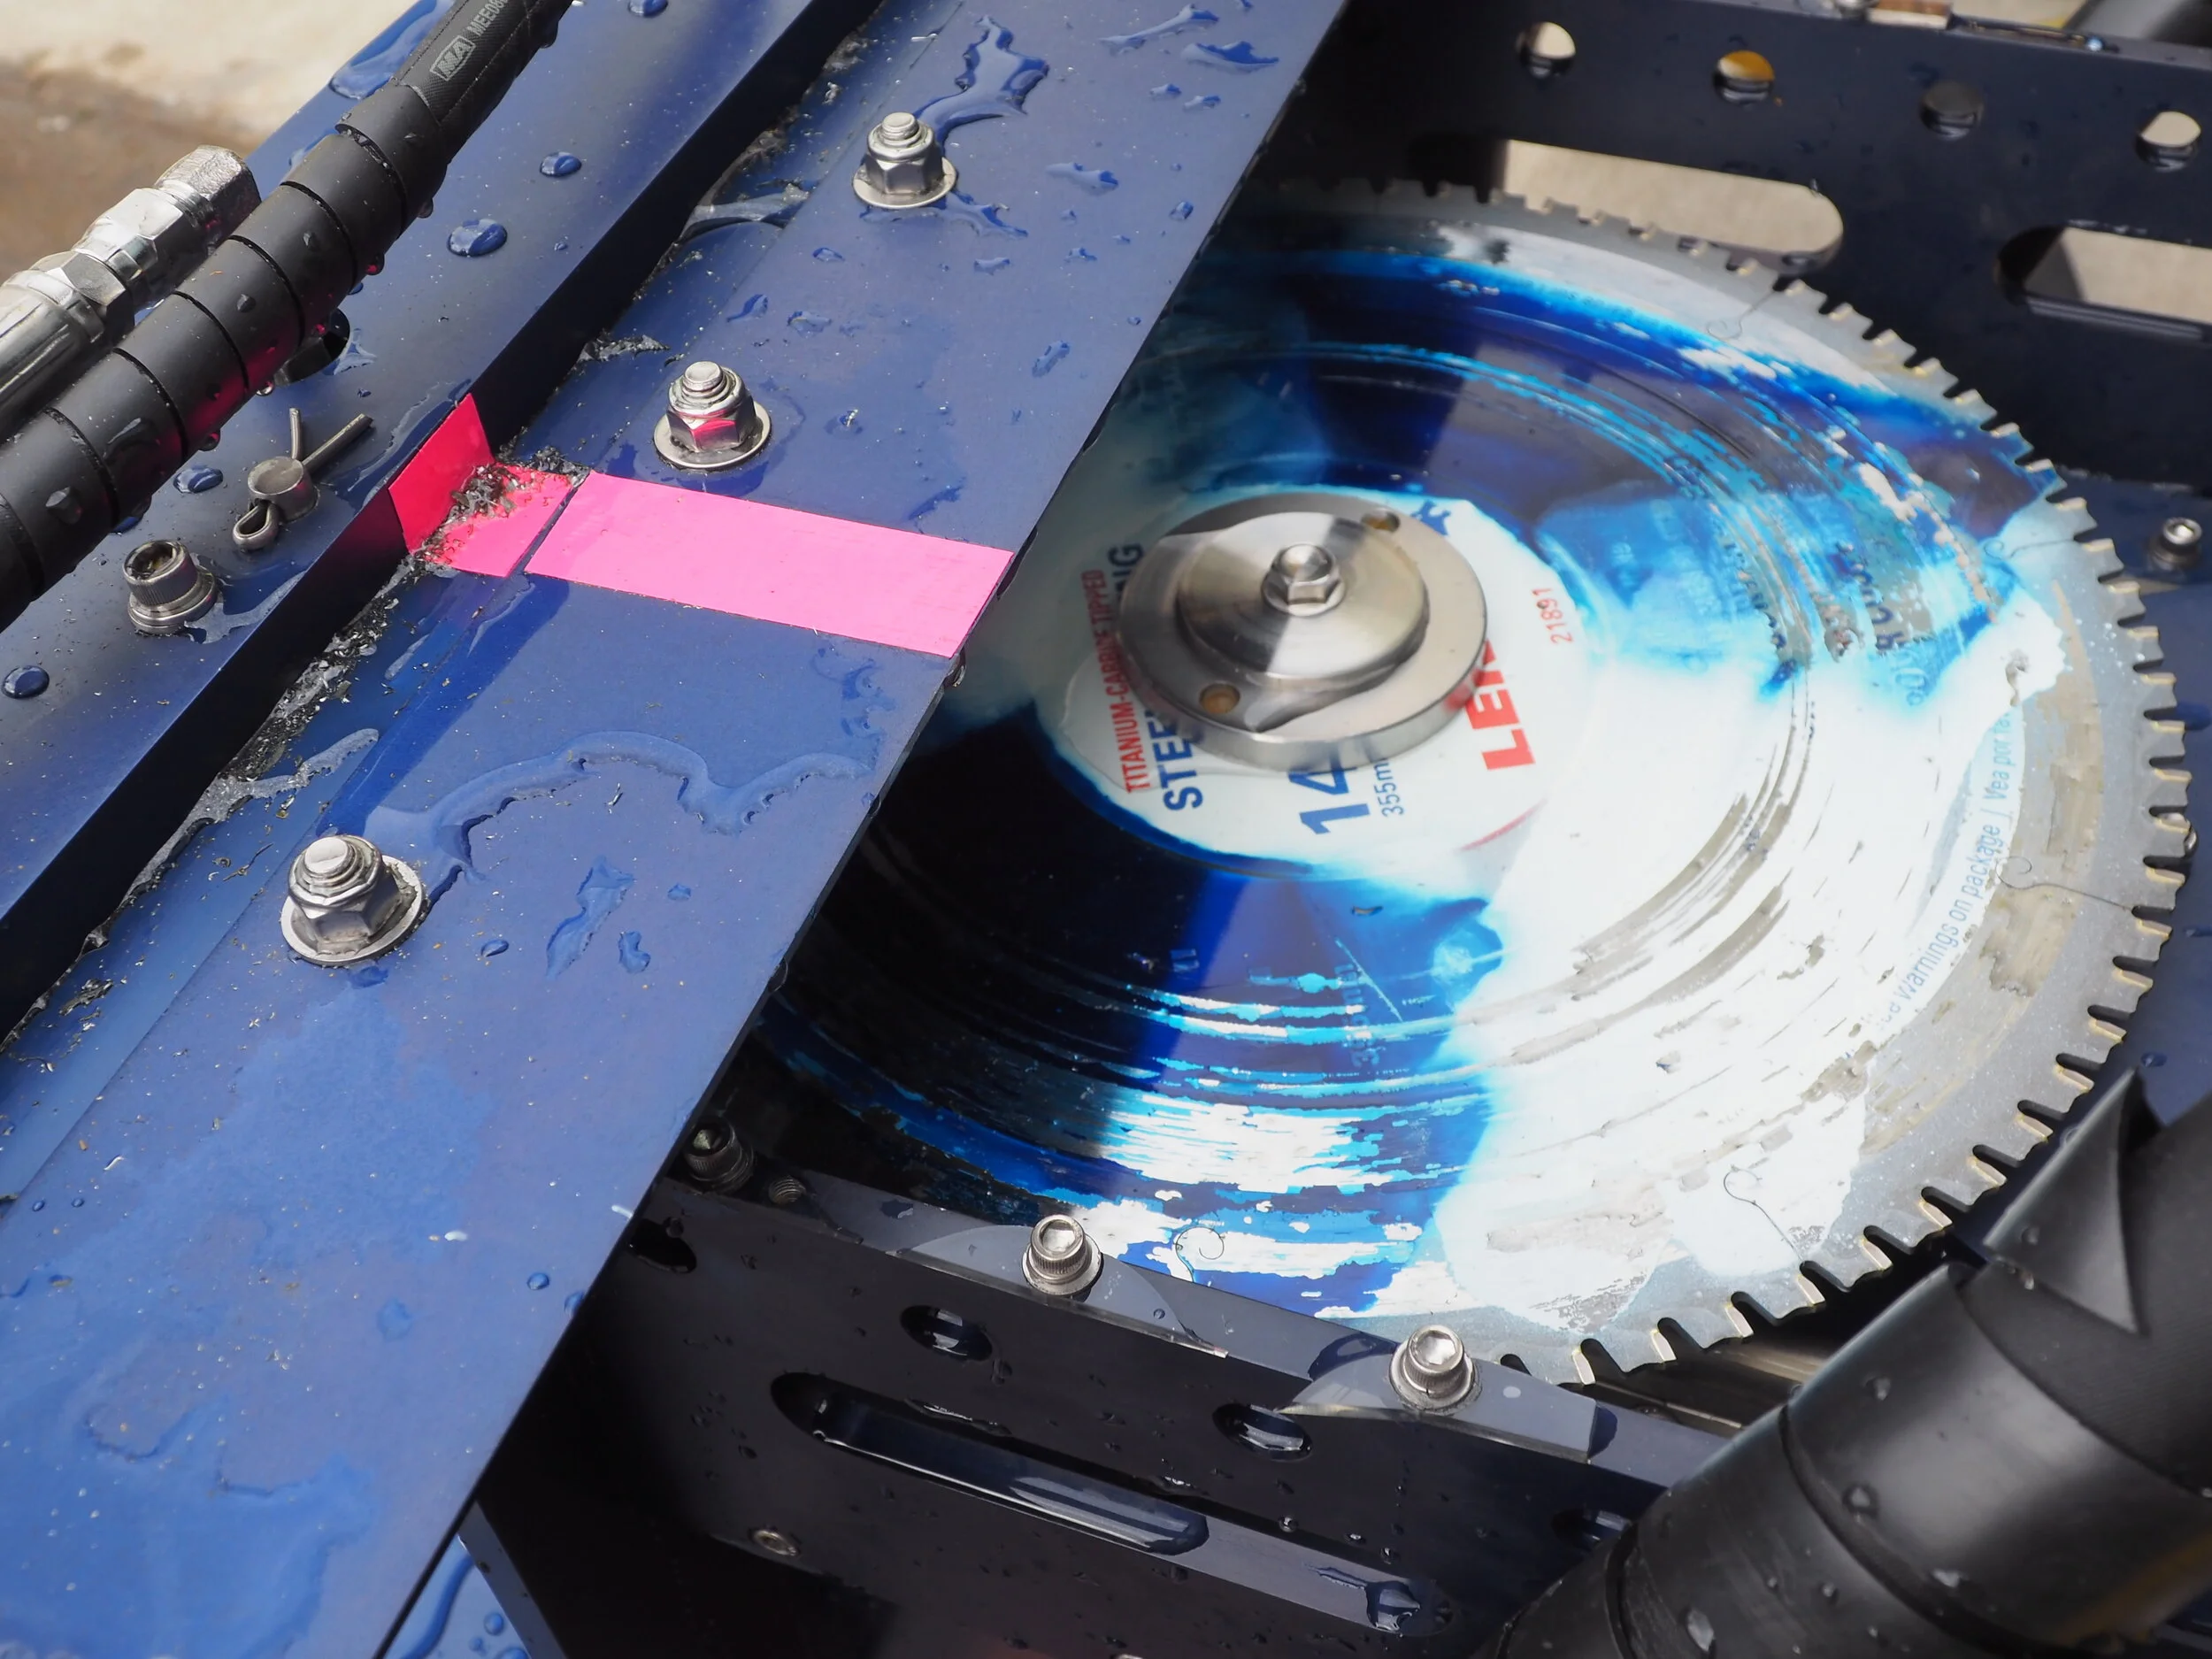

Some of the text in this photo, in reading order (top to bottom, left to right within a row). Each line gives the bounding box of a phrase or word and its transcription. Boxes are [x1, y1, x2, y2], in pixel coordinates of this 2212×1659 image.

[1081, 569, 1112, 625] TIPPED
[1531, 587, 1574, 645] 21891
[1287, 768, 1371, 835] 14
[1371, 758, 1405, 818] 355m
[1900, 922, 1959, 1002] Warnings
[1949, 899, 1973, 922] on
[1961, 824, 2003, 899] package
[1983, 772, 2009, 800] Vea
